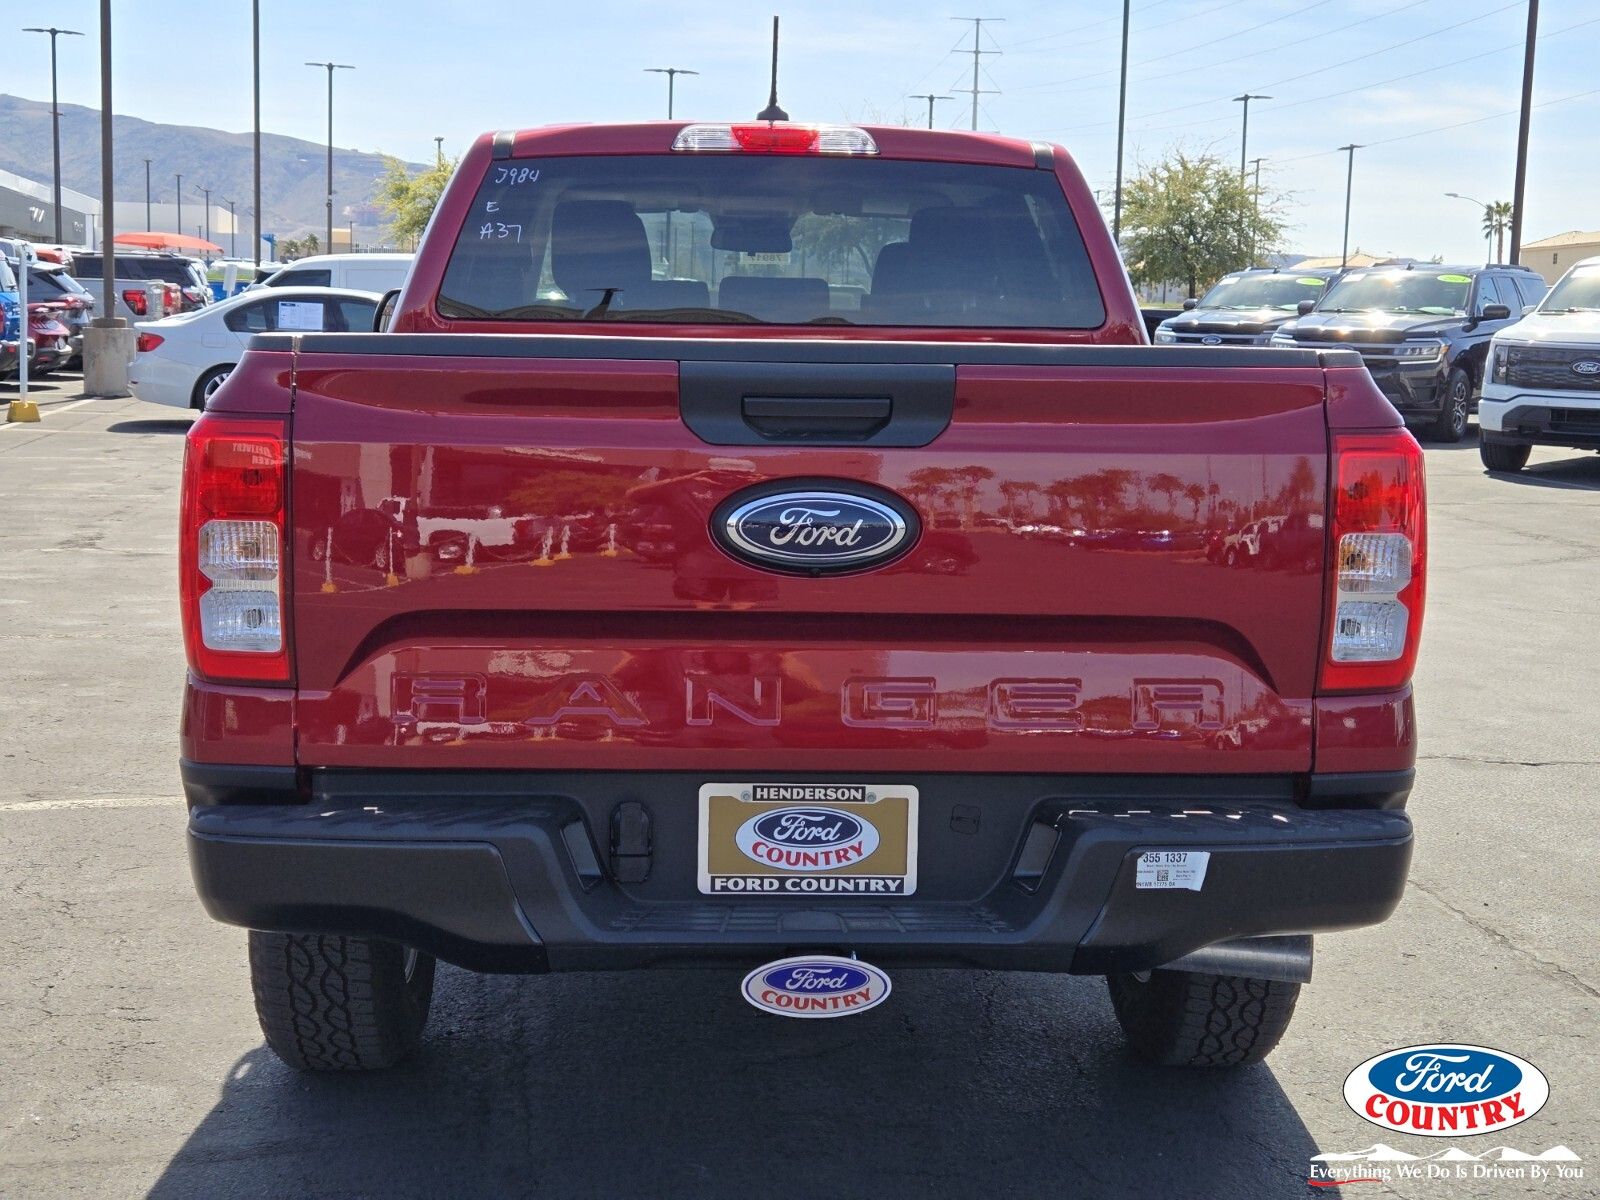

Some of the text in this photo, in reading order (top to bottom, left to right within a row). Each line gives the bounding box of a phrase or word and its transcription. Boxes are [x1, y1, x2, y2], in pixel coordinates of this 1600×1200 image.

[486, 201, 500, 212] E
[480, 222, 522, 243] A37
[769, 507, 864, 546] Ford
[391, 672, 1225, 730] RANGER
[755, 787, 863, 800] HENDERSON
[773, 813, 843, 841] Ford
[752, 840, 864, 867] COUNTRY
[1143, 852, 1188, 863] 355 1337
[714, 877, 902, 891] FORD COUNTRY
[785, 968, 848, 990] Ford
[761, 988, 872, 1010] COUNTRY
